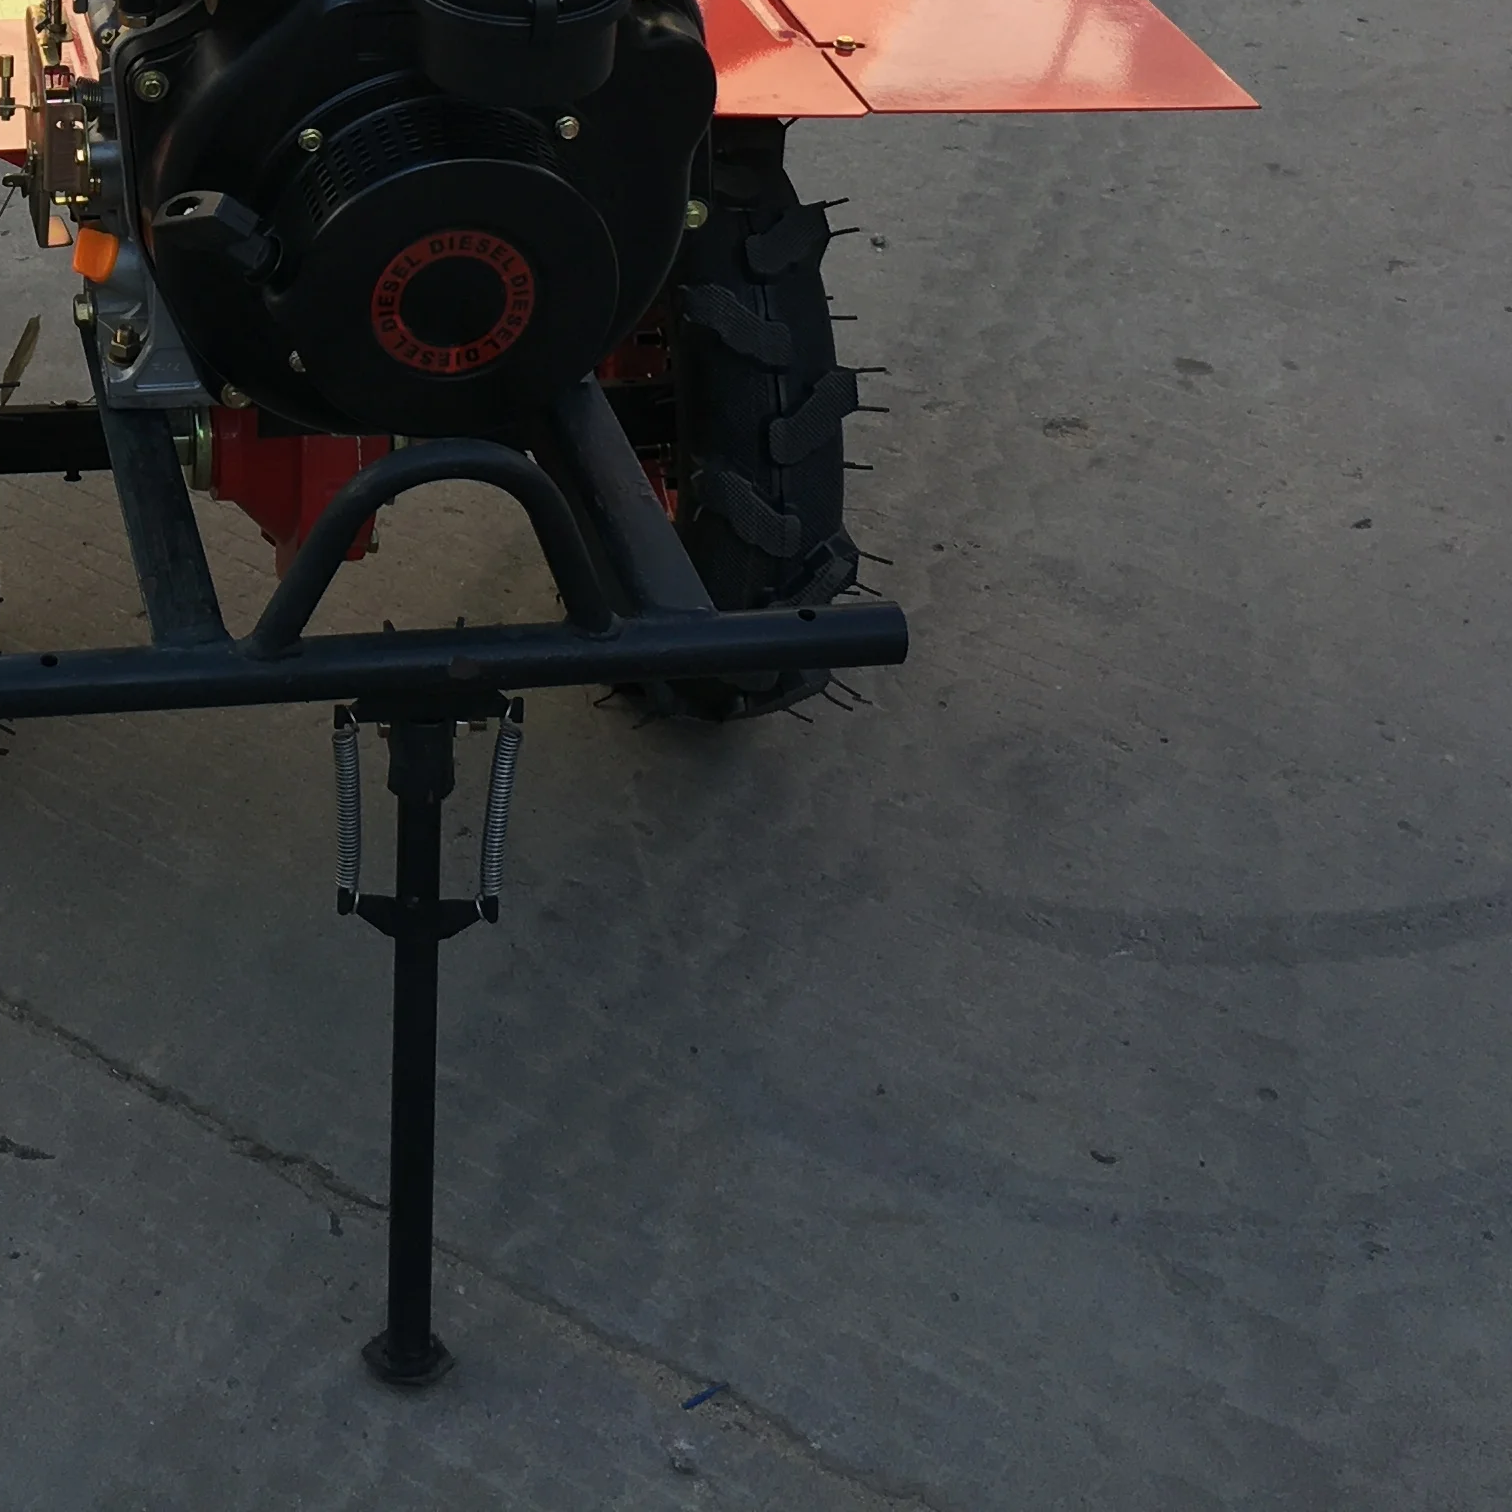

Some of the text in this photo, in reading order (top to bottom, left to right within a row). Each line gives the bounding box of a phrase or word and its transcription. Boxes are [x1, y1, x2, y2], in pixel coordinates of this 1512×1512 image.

[378, 235, 529, 367] DIESEL DIESEL DIESEL DIESEL
